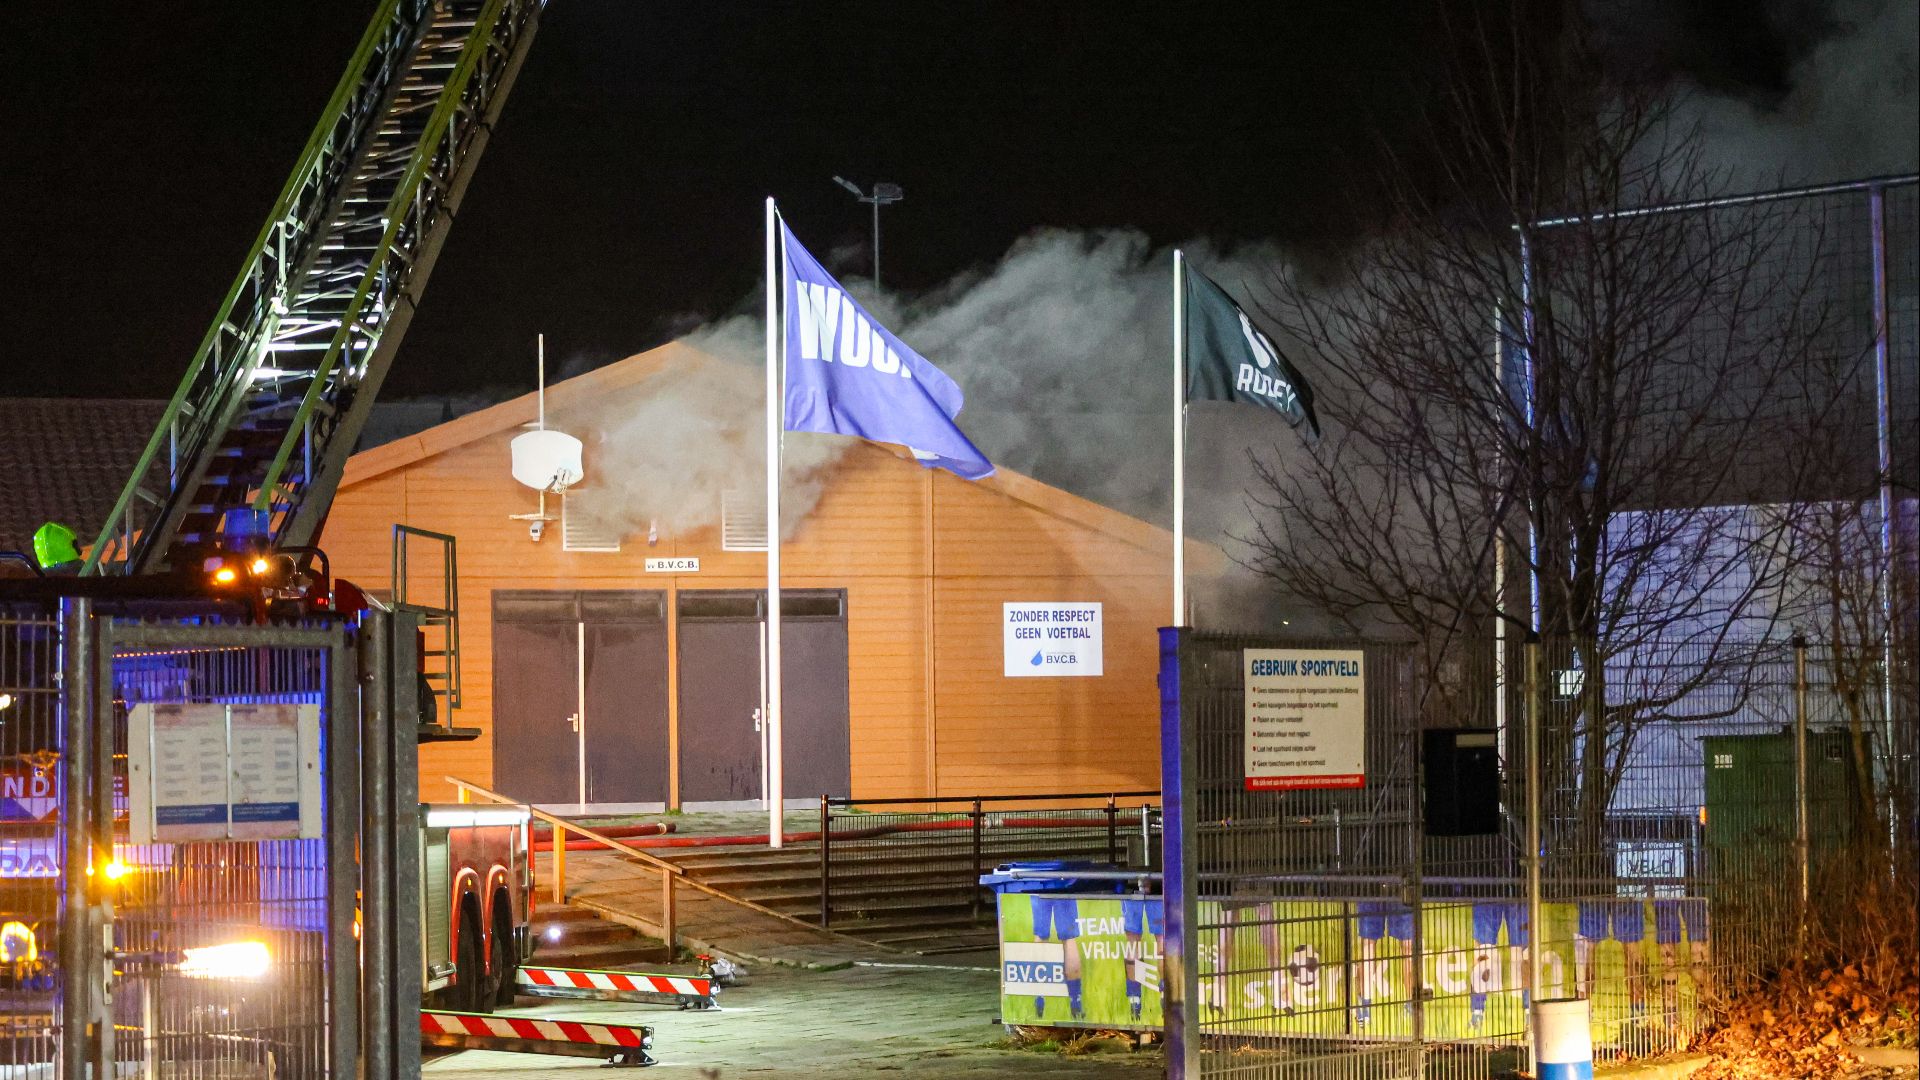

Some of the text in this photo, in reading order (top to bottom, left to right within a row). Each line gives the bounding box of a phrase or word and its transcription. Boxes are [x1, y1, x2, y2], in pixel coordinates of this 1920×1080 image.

[657, 560, 698, 570] B.V.C.B.
[1009, 610, 1096, 622] ZONDER RESPECT
[1015, 627, 1091, 640] GEEN VOETBAL
[1046, 654, 1078, 664] B.V.C.B.
[1251, 659, 1359, 677] GEBRUIK SPORTVELD
[1075, 917, 1126, 937] TEAM
